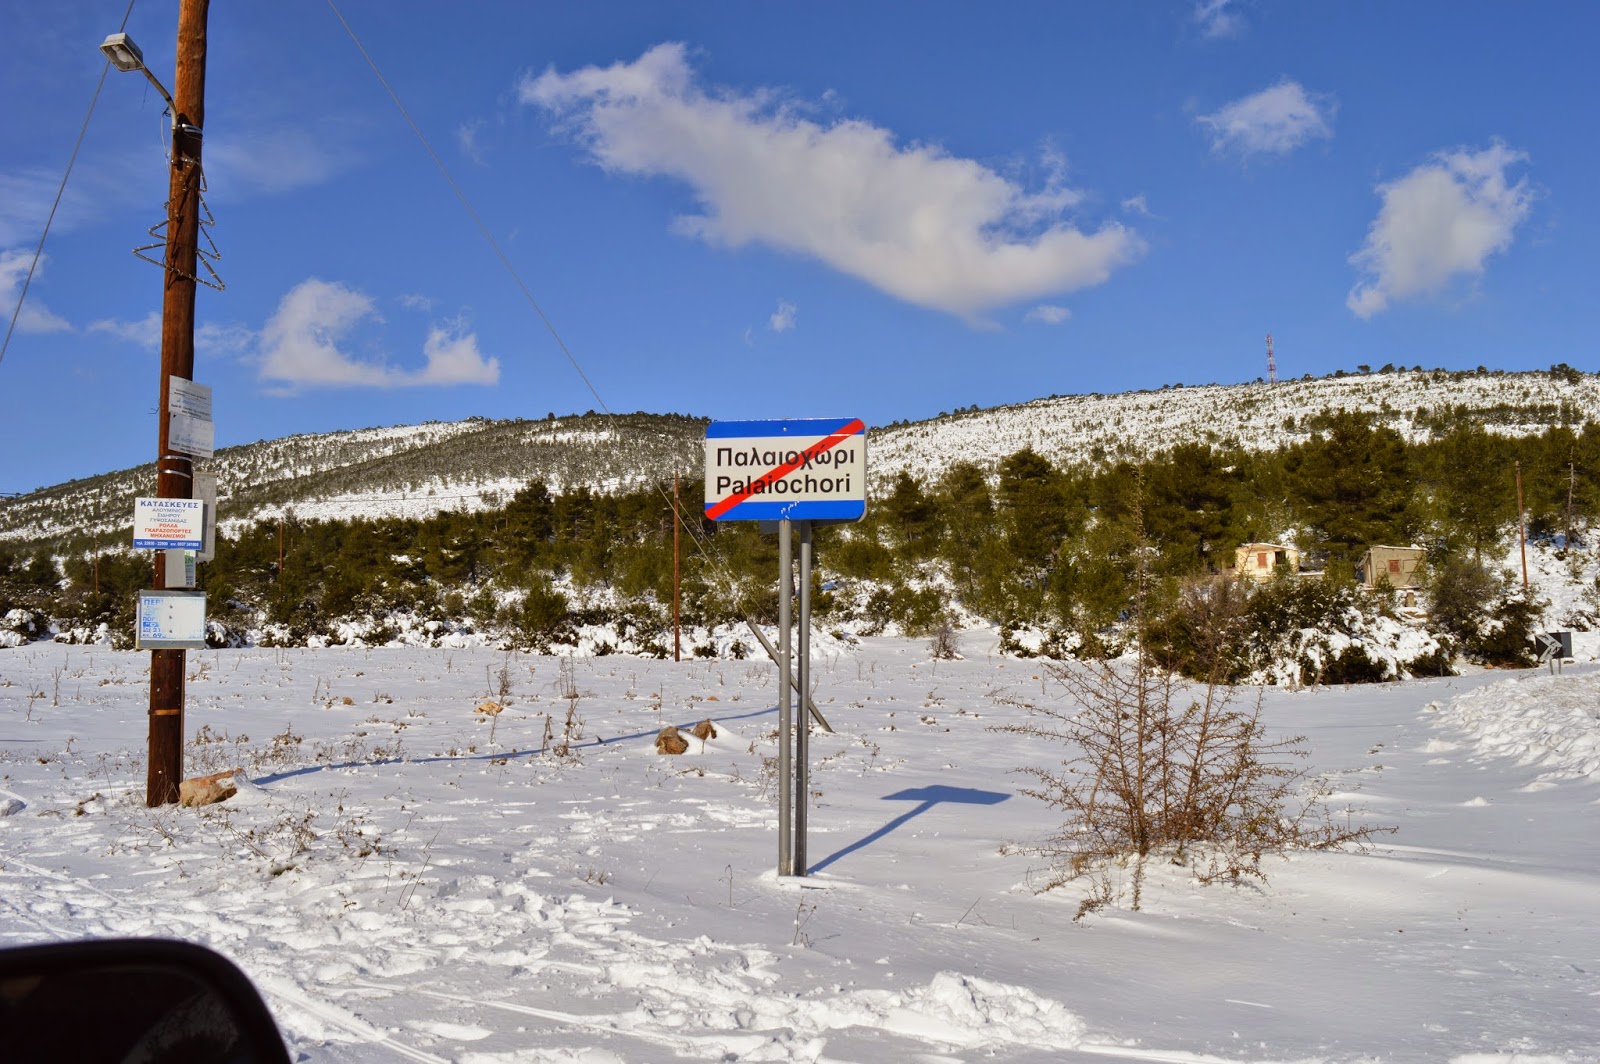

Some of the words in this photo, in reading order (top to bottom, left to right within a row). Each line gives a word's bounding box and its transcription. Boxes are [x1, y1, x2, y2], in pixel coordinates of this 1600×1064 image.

[717, 445, 855, 470] Παλαιοχώρι
[716, 474, 851, 495] Palaiochori
[140, 500, 199, 509] ΚΑΤΑΣΚΕΥΕΣ
